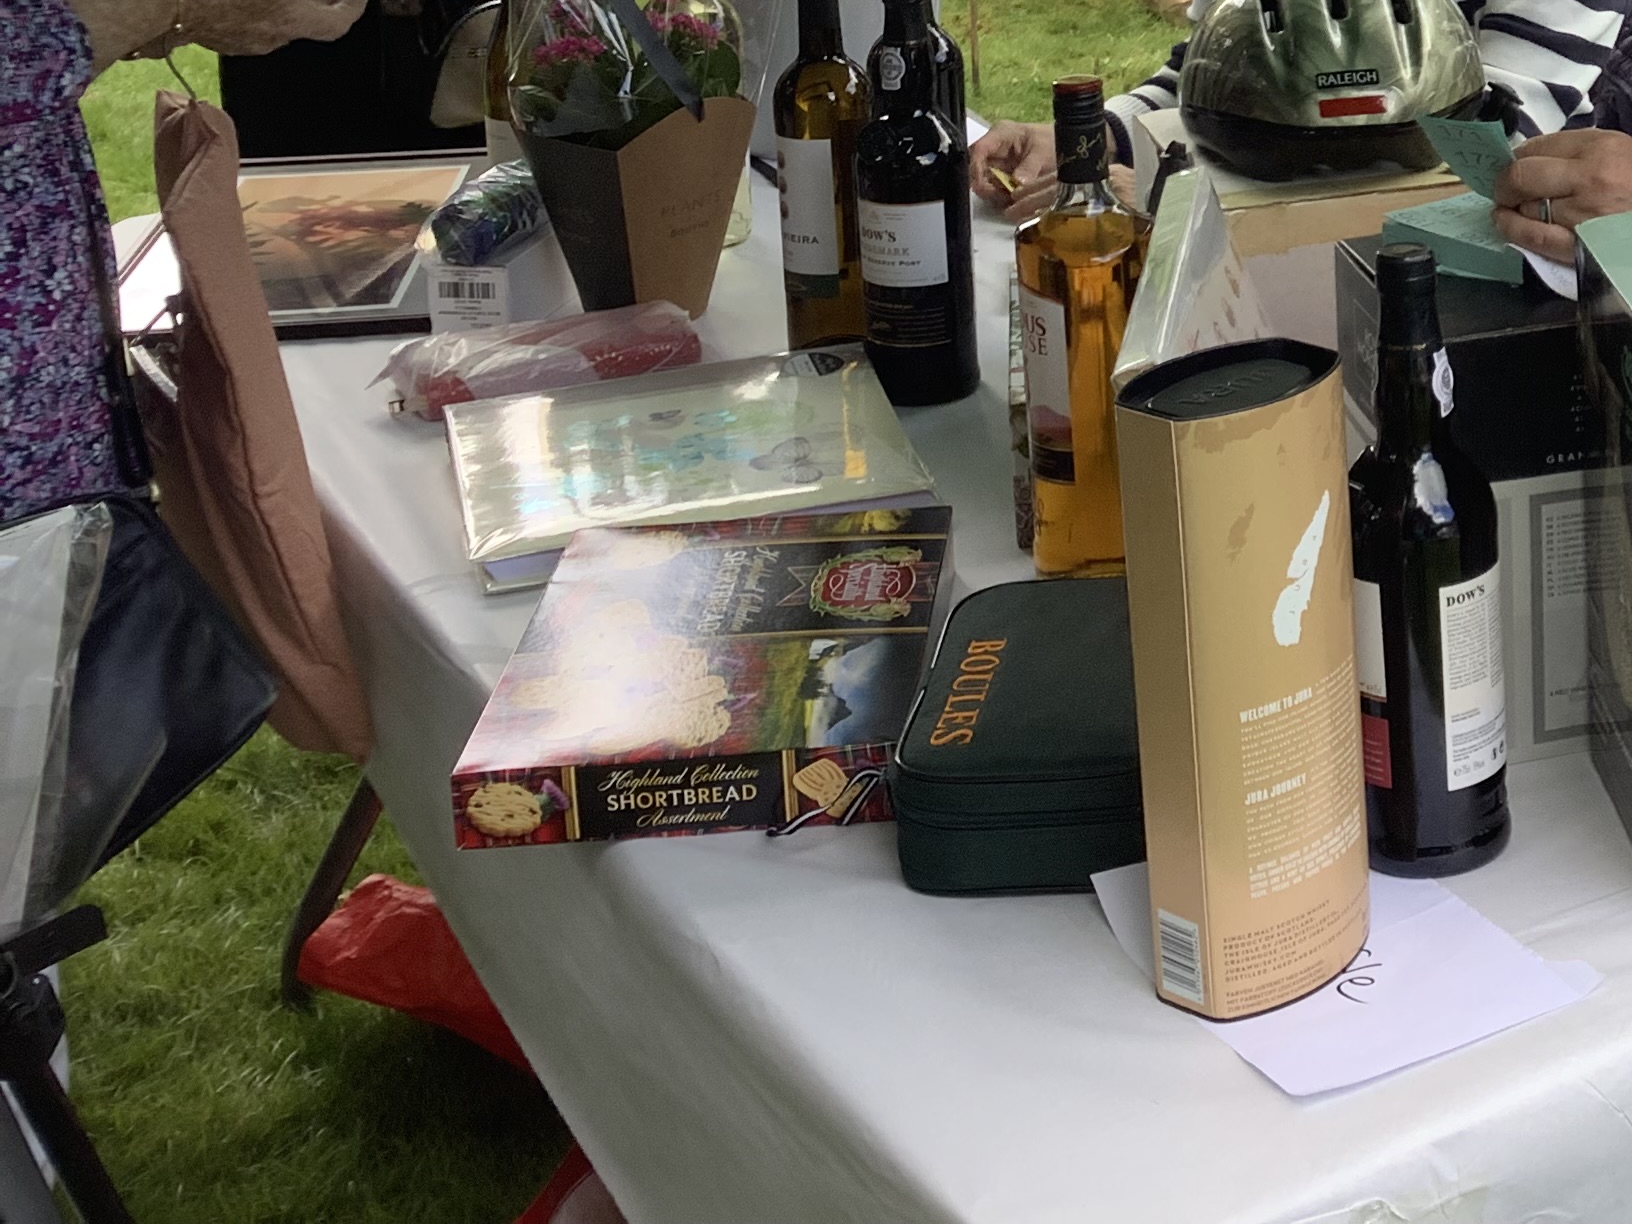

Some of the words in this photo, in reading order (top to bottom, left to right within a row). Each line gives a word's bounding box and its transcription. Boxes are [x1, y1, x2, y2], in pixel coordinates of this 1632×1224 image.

[1317, 71, 1378, 87] RALEIGH
[1446, 584, 1485, 608] DOW'S
[930, 637, 1008, 746] BOULES
[1239, 699, 1283, 724] WELCOME
[1283, 695, 1294, 710] TO
[597, 766, 689, 795] Highland
[690, 763, 760, 787] Collection
[1244, 788, 1269, 806] JURA
[1270, 772, 1307, 798] JOURNEY
[607, 784, 758, 812] SHORTBREAD
[636, 805, 731, 827] Assortment
